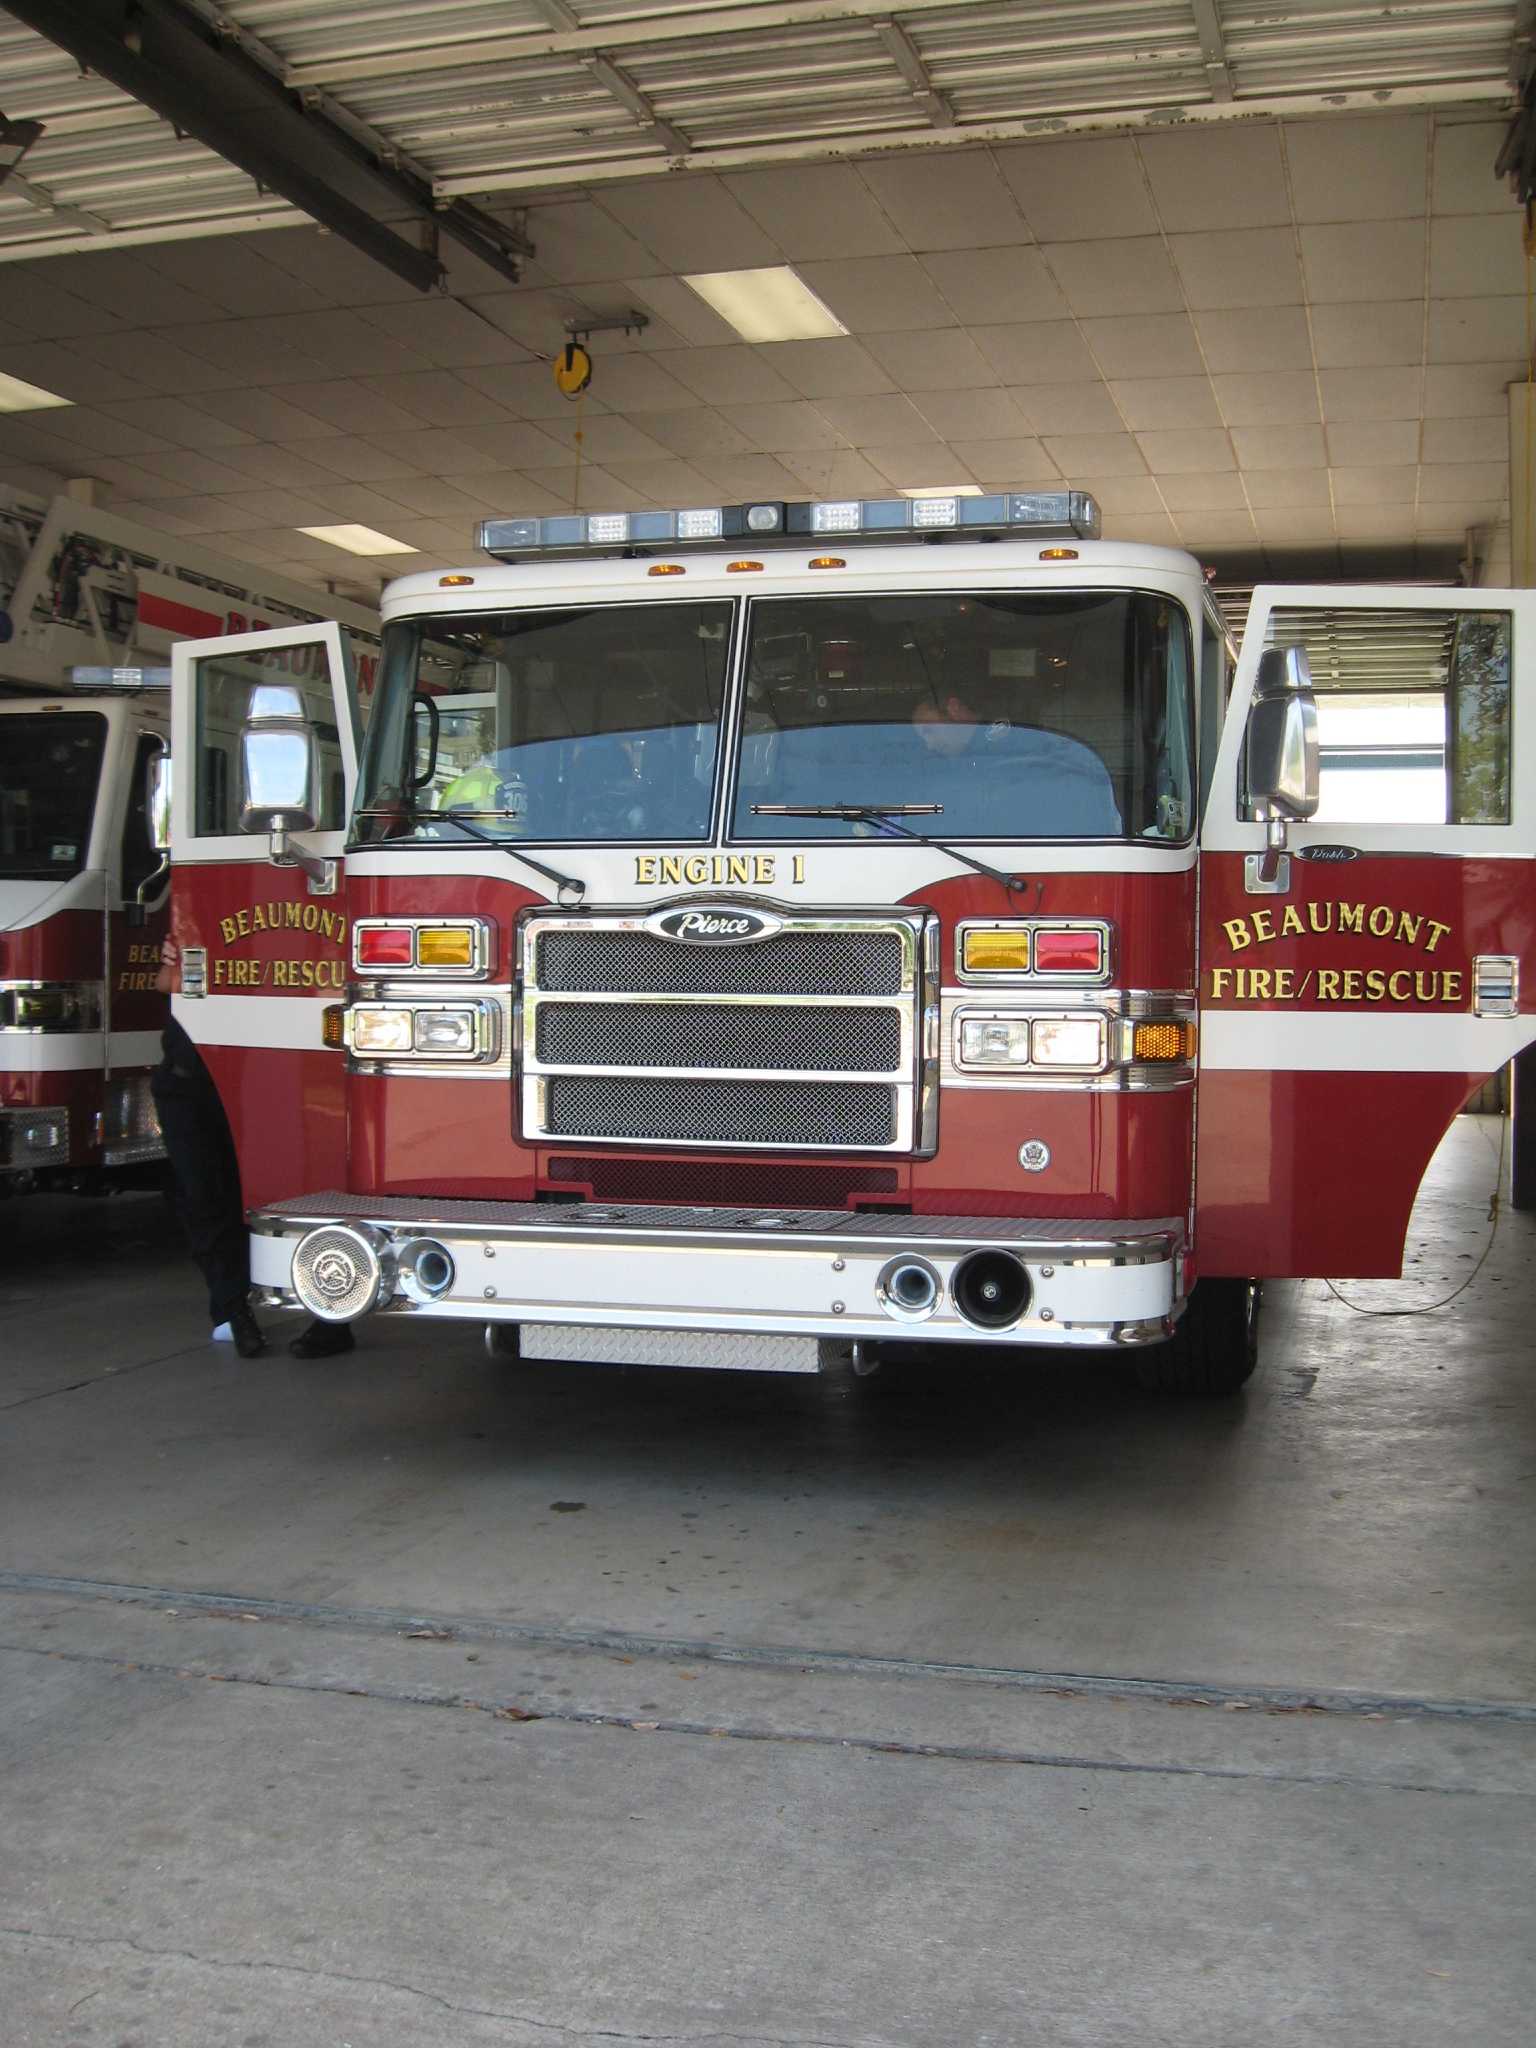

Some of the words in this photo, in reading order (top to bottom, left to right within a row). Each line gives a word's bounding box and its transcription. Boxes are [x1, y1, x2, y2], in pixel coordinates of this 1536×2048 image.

[635, 854, 776, 885] ENGINE
[676, 912, 750, 938] Pierce
[1222, 902, 1451, 952] BEAUMONT
[213, 959, 346, 988] FIRE/RESCU
[1210, 968, 1463, 1002] FIRE/RESCUE
